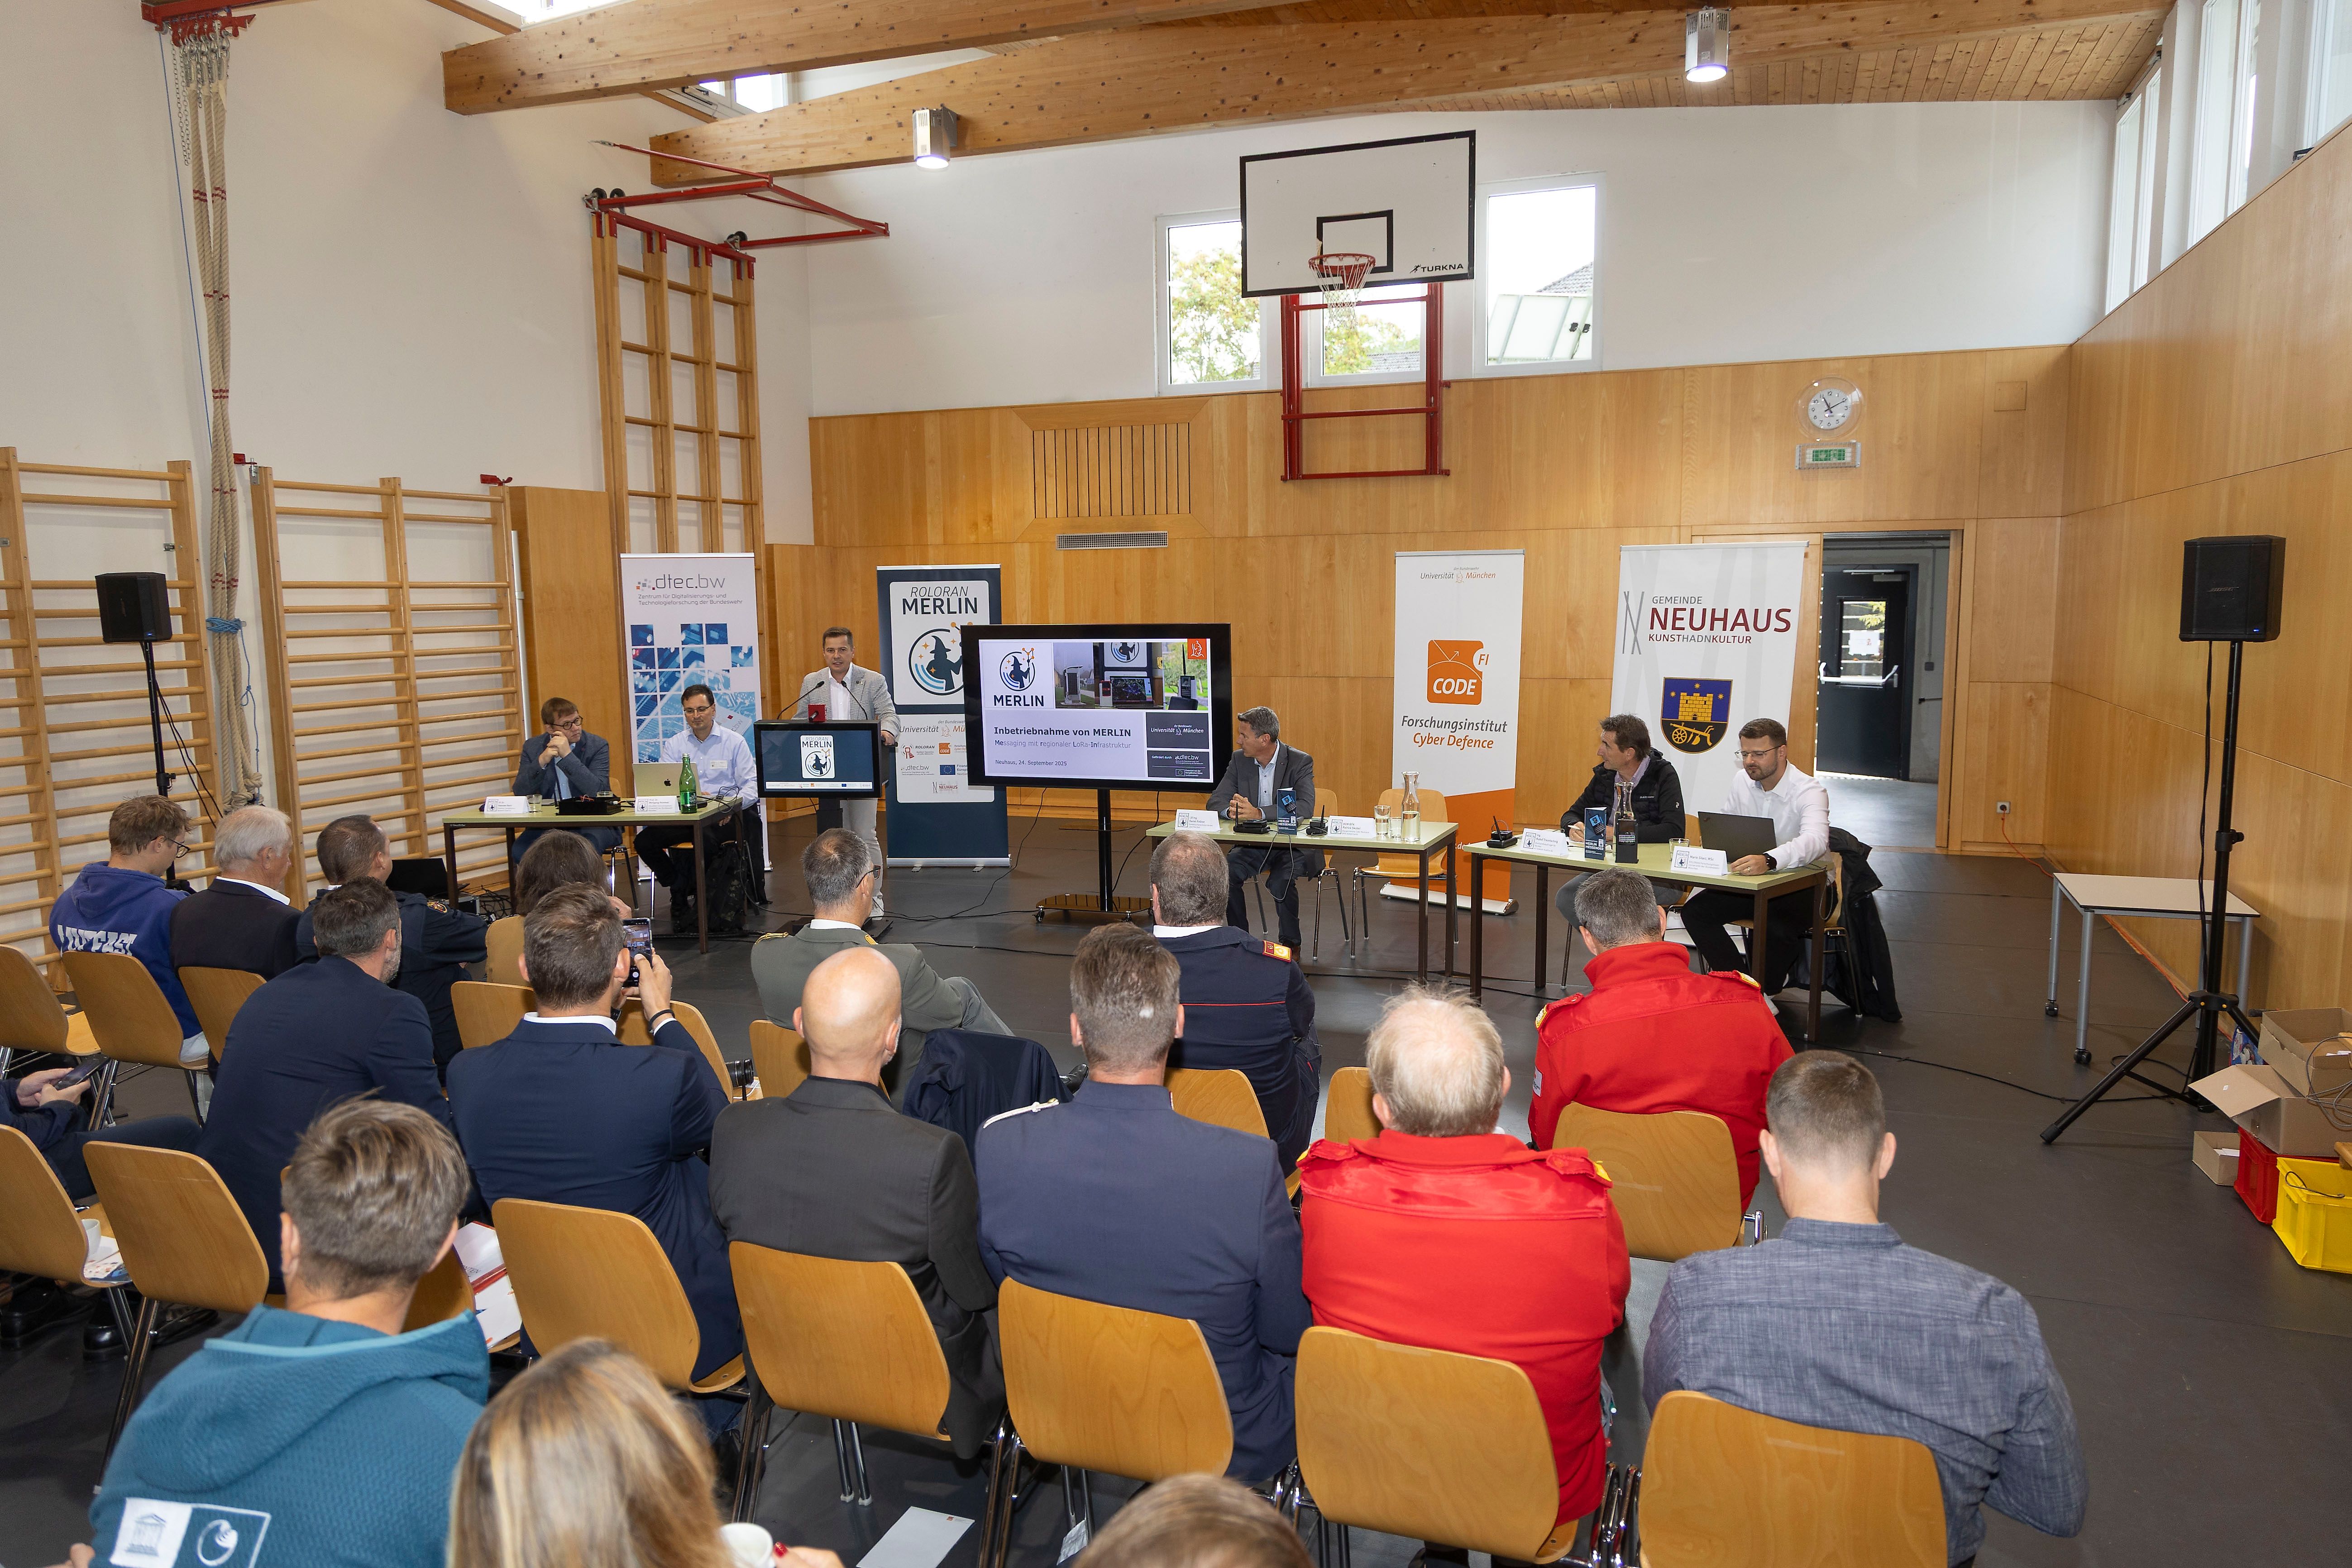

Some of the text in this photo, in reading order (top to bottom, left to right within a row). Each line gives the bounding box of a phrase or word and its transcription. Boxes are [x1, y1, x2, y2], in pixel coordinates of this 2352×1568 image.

[1421, 263, 1463, 272] TURKNA
[910, 586, 968, 597] ROLORAN
[1652, 596, 1702, 604] GEMEINDE
[902, 597, 978, 615] MERLIN
[1649, 607, 1792, 632] NEUHAUS
[1649, 634, 1752, 644] KUNSTHADNKULTUR
[1478, 654, 1489, 665] FI
[1433, 678, 1477, 695] CODE
[993, 695, 1044, 707] MERLIN
[1401, 715, 1507, 733] Forschungsinstitut
[994, 727, 1070, 736] Inbetriebnahme
[1413, 732, 1494, 750] Cyber Defence
